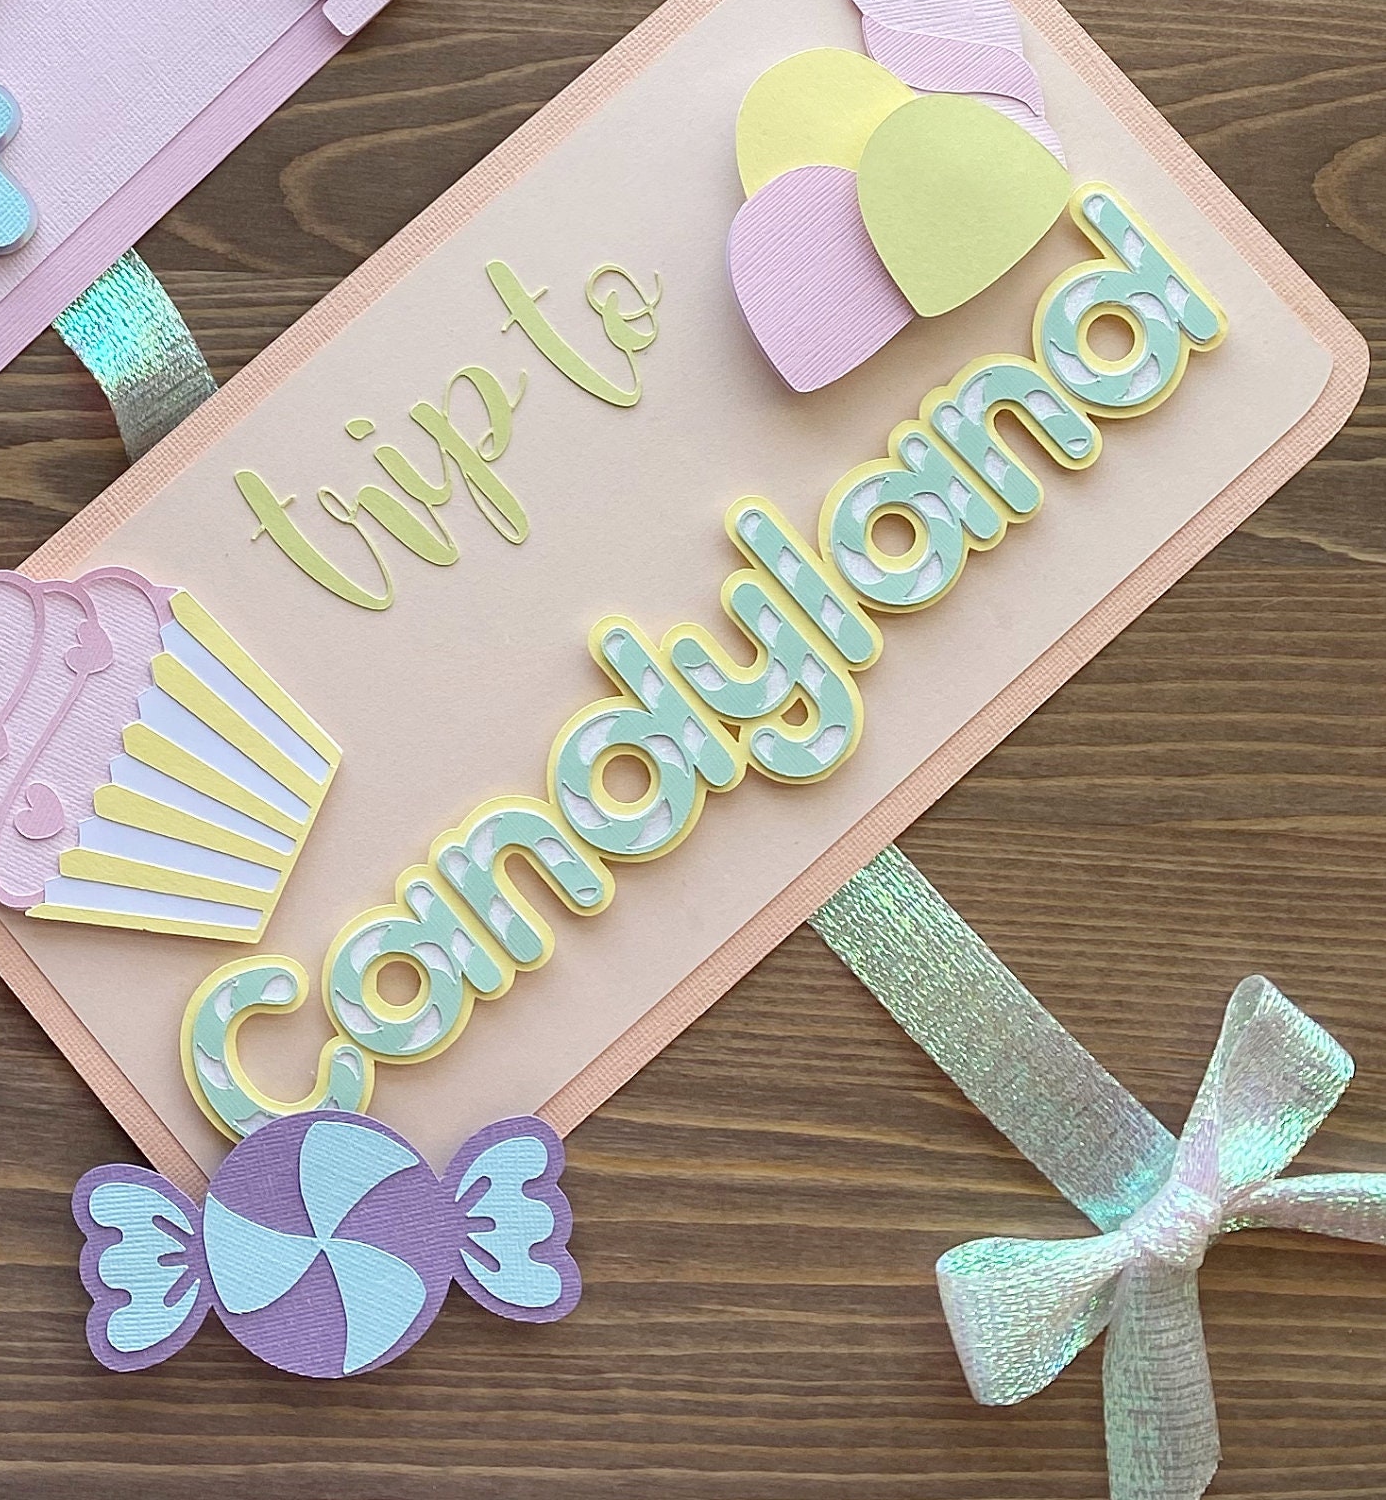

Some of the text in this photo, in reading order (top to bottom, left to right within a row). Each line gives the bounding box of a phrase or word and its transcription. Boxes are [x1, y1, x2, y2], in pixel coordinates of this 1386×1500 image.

[180, 181, 1230, 1145] Candyland
[233, 257, 663, 612] trip to
